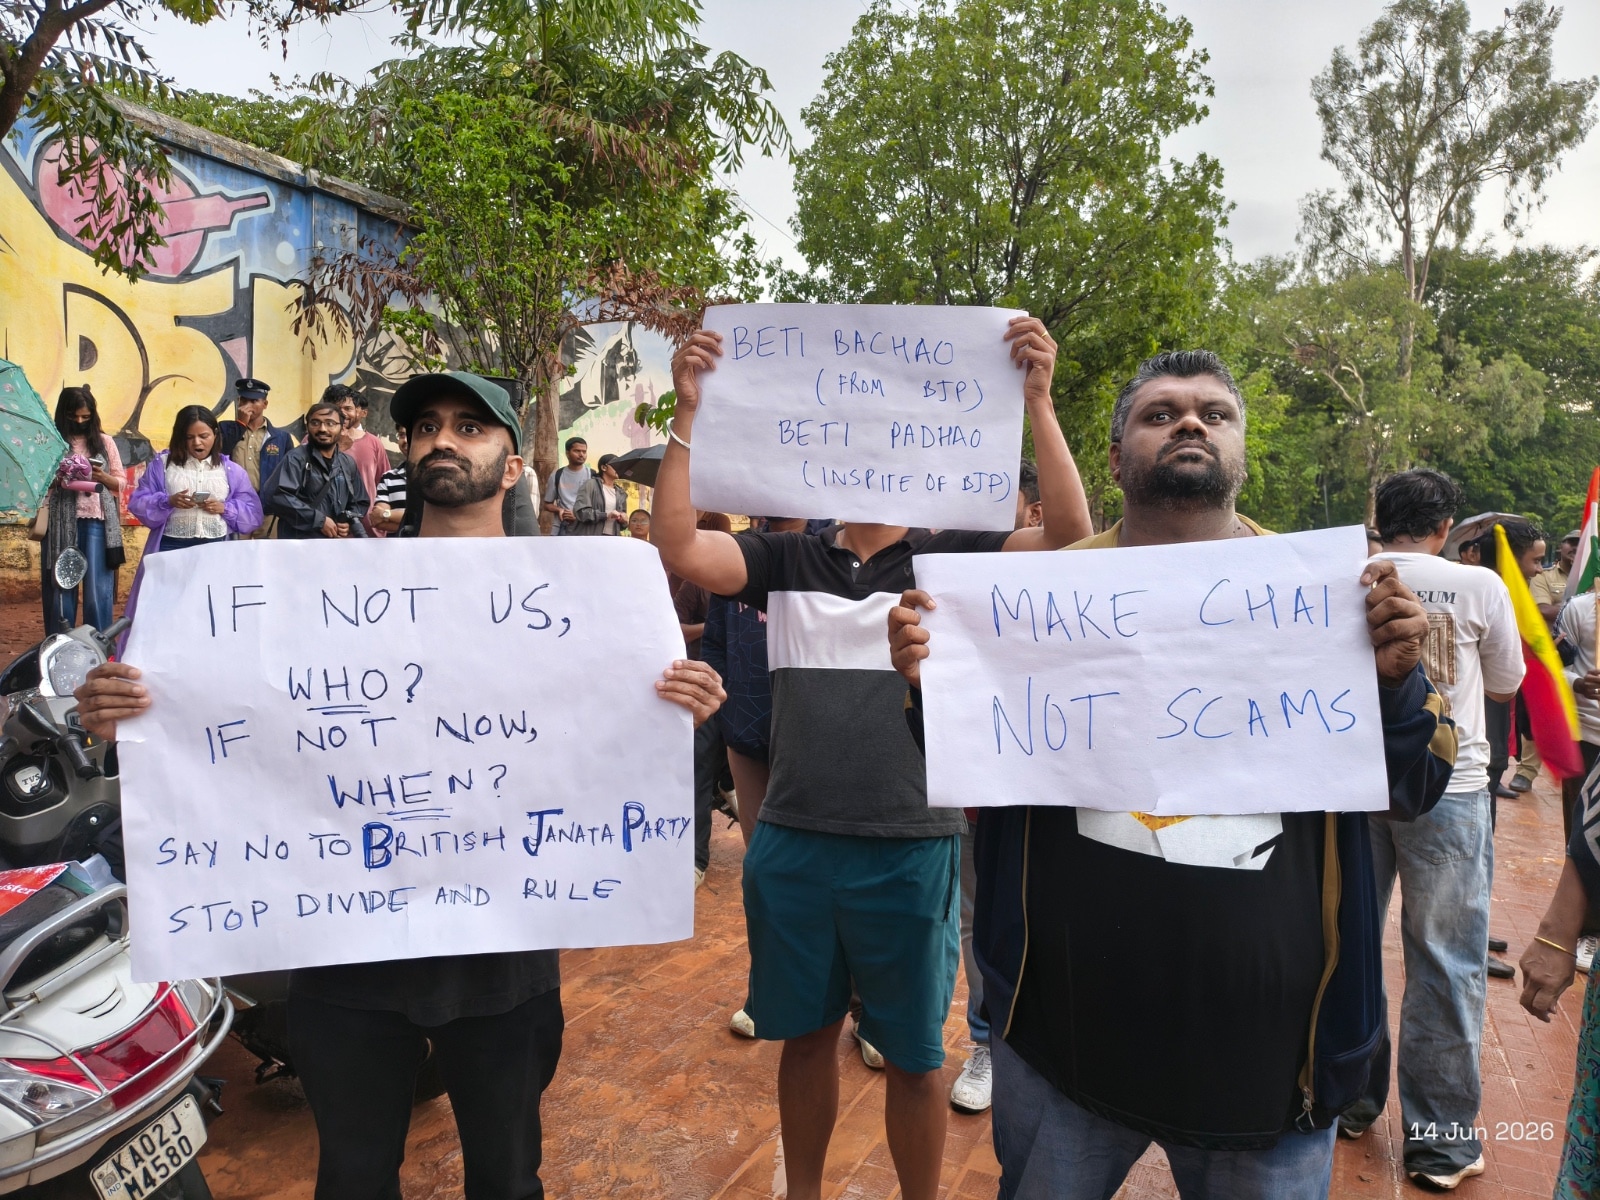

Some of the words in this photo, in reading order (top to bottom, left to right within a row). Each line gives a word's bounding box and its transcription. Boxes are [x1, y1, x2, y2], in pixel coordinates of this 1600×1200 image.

[732, 326, 805, 361] BETI
[834, 330, 954, 366] BACHAO
[816, 368, 885, 406] (FROM
[923, 378, 984, 413] BJP)
[778, 419, 849, 447] BETI
[890, 421, 981, 449] PADHAO
[802, 460, 914, 493] (INSPITE
[926, 472, 947, 492] OF
[962, 471, 1011, 503] BJP)
[207, 584, 267, 638] IF
[321, 584, 439, 629] NOT
[490, 582, 571, 638] US,
[991, 583, 1149, 643] MAKE
[1199, 578, 1329, 629] CHAI
[1411, 590, 1457, 604] EUM
[288, 662, 424, 704] WHO?
[205, 719, 251, 765] IF
[296, 716, 397, 753] NOT
[435, 709, 538, 745] NOW,
[992, 676, 1121, 757] NOT
[1156, 687, 1356, 740] SCAMS
[22, 773, 40, 786] TVS
[326, 763, 508, 810] WHEN?
[155, 836, 218, 868] SAY
[244, 835, 289, 862] NO
[308, 832, 352, 860] TO
[361, 821, 506, 870] BRITISH
[521, 808, 615, 857] JANATA
[621, 801, 693, 853] PARTY
[168, 899, 269, 934] STOP
[296, 886, 417, 918] DIVIDE
[434, 884, 491, 907] AND
[522, 877, 622, 902] RULE
[111, 1111, 182, 1180] KA02J
[124, 1135, 193, 1200] M4580
[107, 1182, 122, 1196] IND
